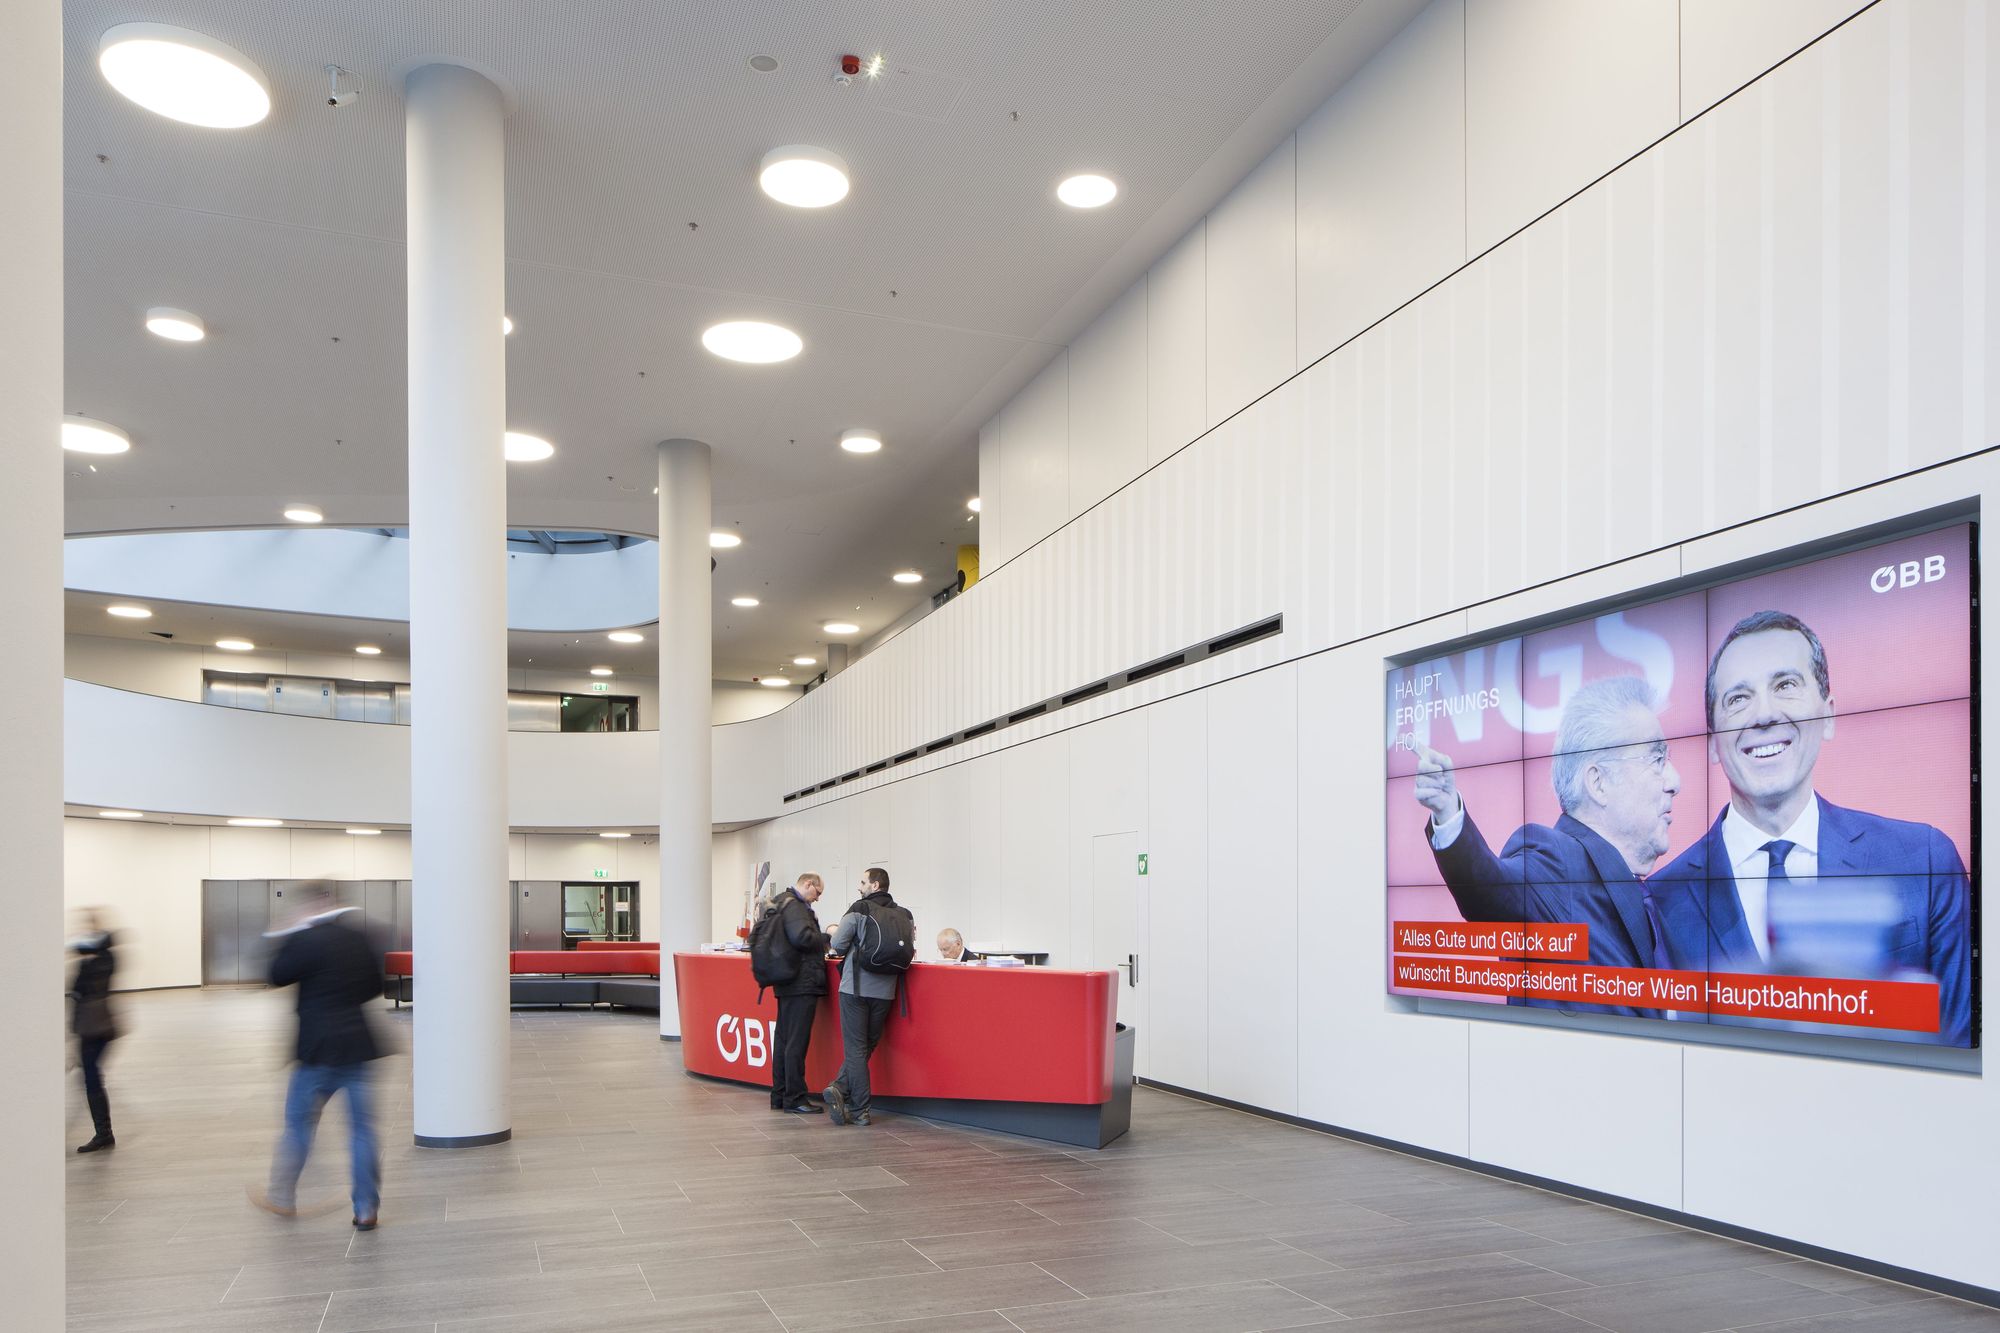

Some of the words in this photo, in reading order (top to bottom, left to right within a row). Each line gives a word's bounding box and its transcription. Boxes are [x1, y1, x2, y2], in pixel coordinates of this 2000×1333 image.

[1871, 555, 1945, 593] ÖBB
[1395, 673, 1442, 700] HAUPT
[1395, 688, 1499, 726] ERÖFFNUNGS
[1434, 929, 1466, 949] Gute
[1470, 932, 1496, 950] und
[1500, 931, 1544, 952] Glück
[1399, 963, 1451, 983] wünscht
[1455, 966, 1578, 993] Bundespräsident
[1583, 973, 1645, 998] Fischer
[1650, 977, 1697, 1002] Wien
[1705, 981, 1875, 1015] Hauptbahnhof.
